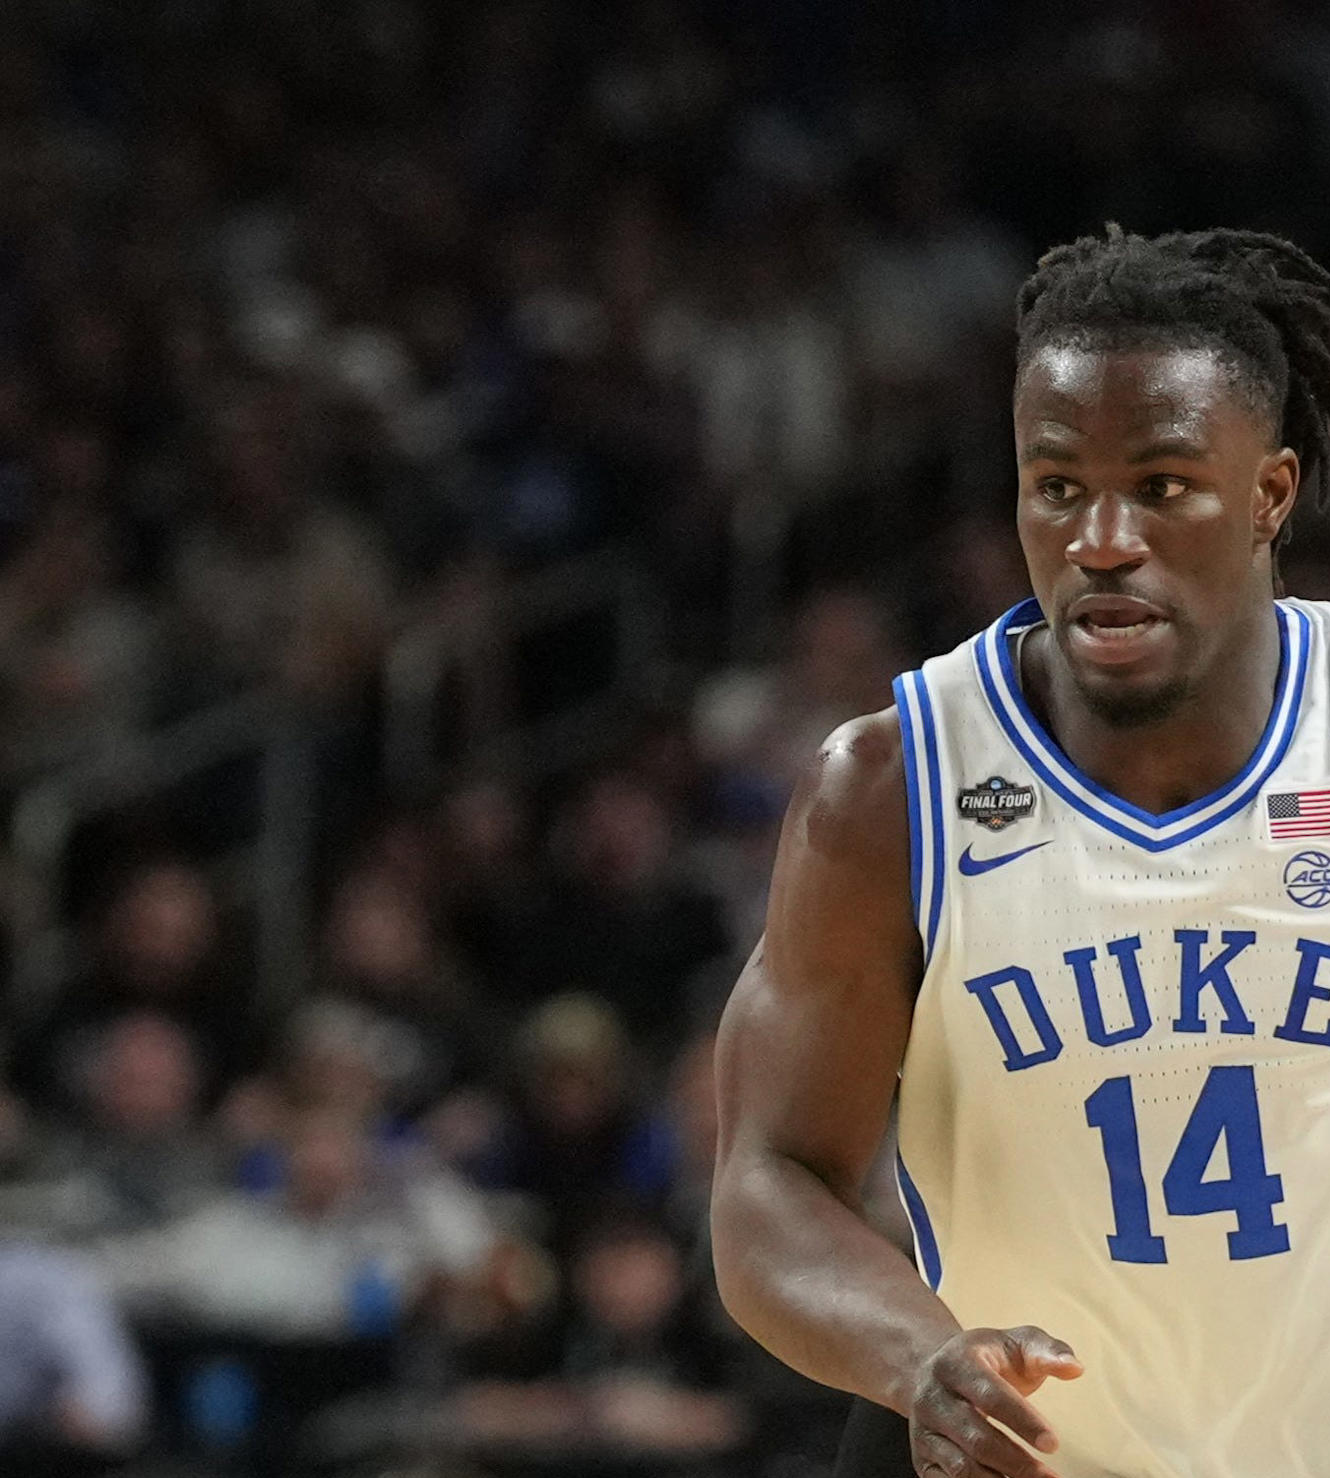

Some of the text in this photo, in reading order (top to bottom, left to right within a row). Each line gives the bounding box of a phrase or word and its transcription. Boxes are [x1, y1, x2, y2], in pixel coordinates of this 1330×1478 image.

[961, 792, 1032, 809] FINAL FOUR
[1084, 1065, 1292, 1264] 14
